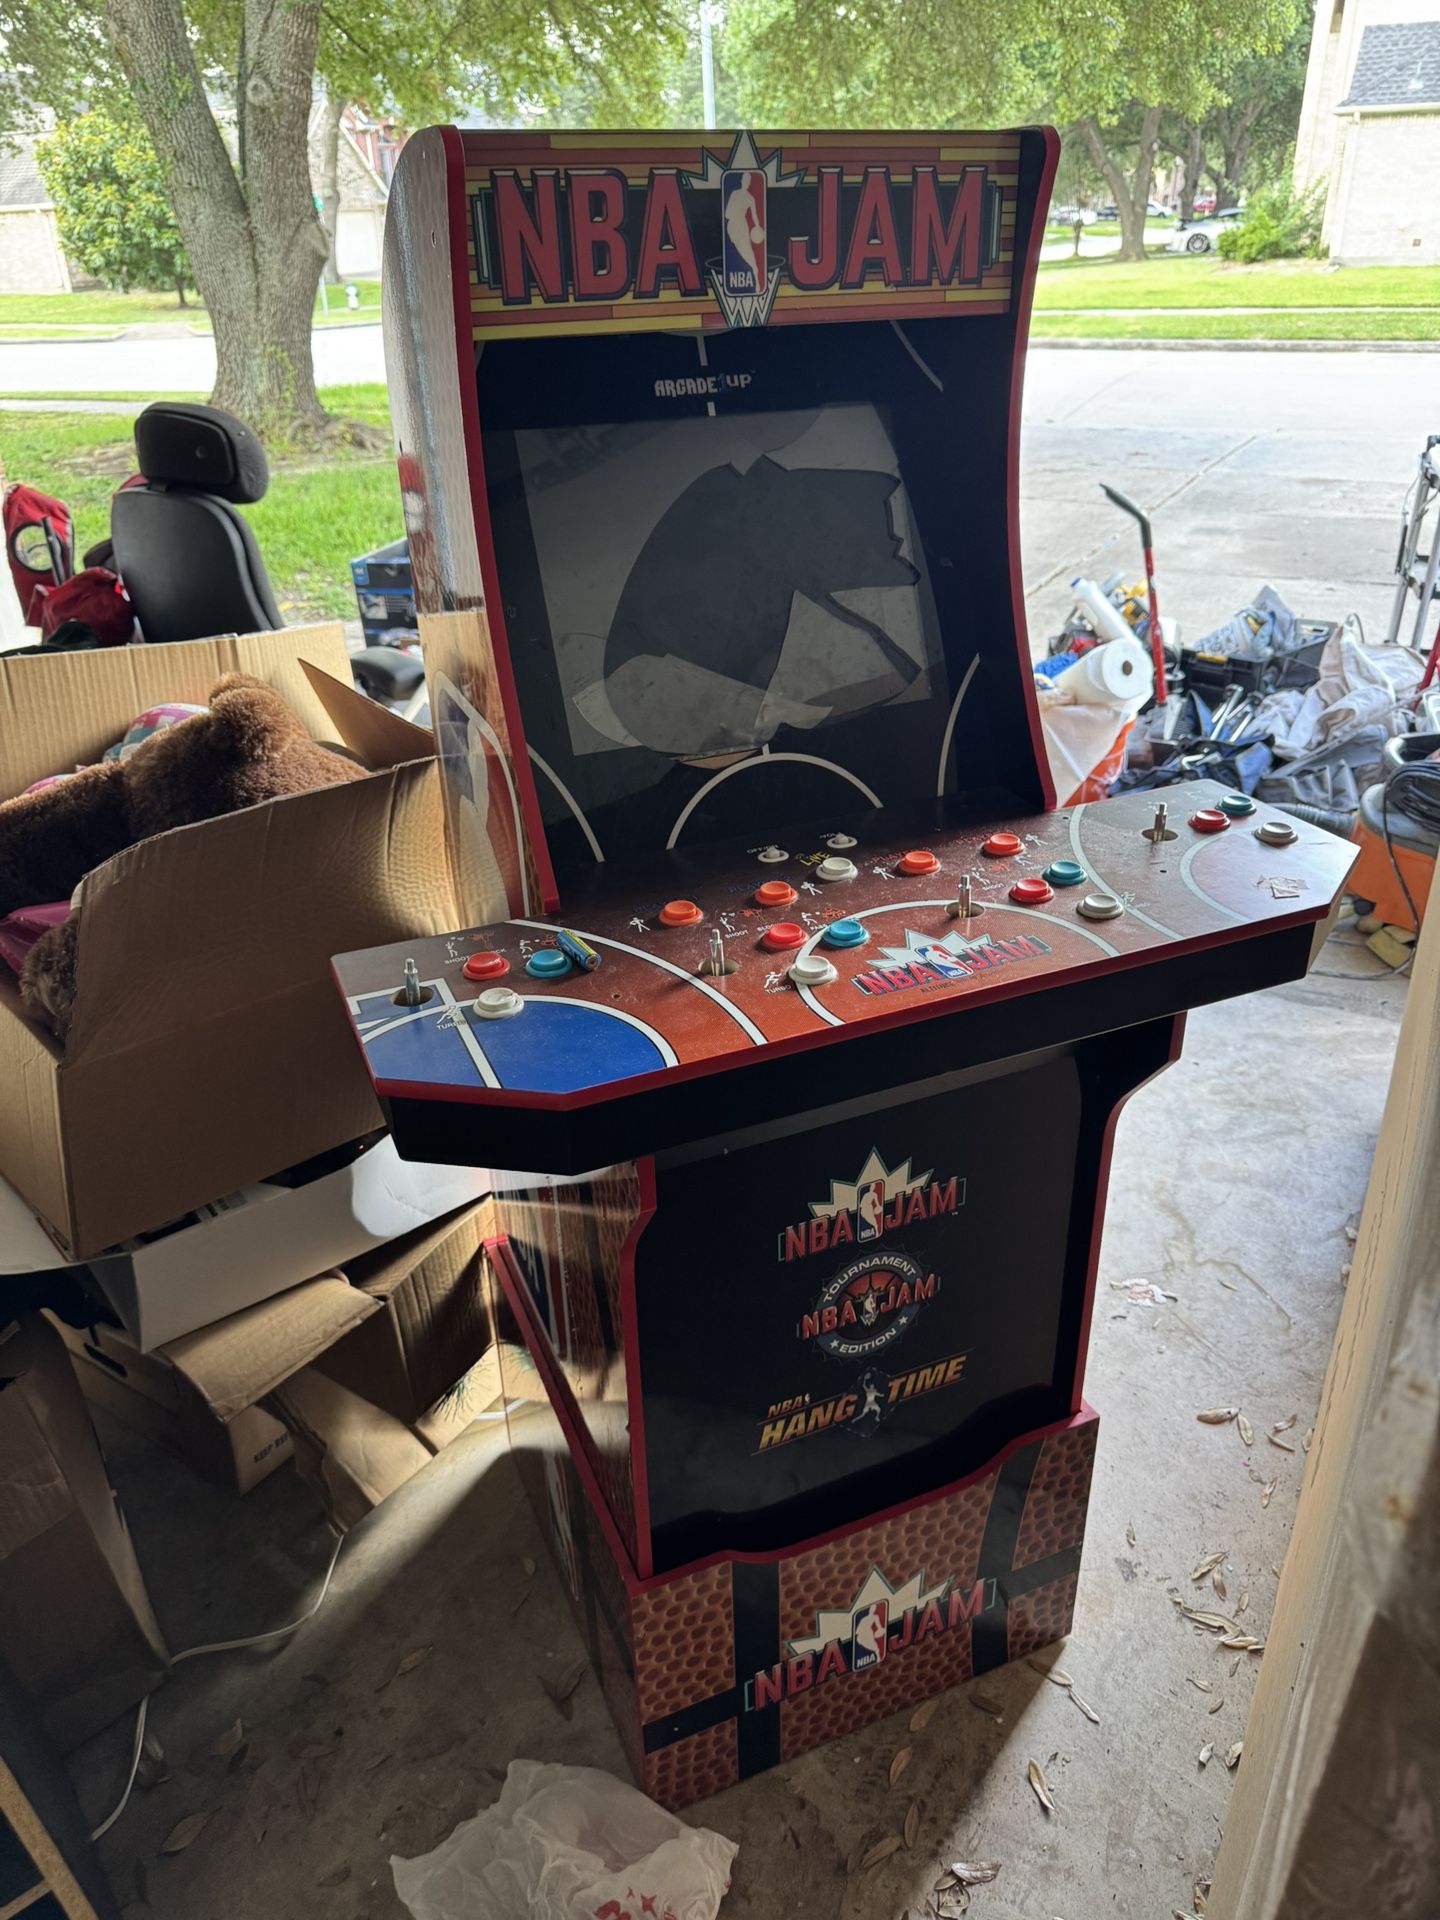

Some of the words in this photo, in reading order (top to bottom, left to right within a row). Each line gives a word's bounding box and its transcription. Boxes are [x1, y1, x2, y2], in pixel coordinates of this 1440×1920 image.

[489, 167, 710, 305] NBA
[787, 165, 988, 291] JAM
[729, 271, 754, 289] NBA
[725, 929, 749, 939] SHOOT
[858, 961, 944, 996] NBA
[965, 935, 1044, 971] JAM
[946, 967, 965, 977] NBA
[765, 983, 792, 995] TURBO
[783, 1209, 854, 1262] NBA
[885, 1176, 958, 1229] JAM
[860, 1229, 876, 1239] NBA
[823, 1255, 917, 1303] TOURNAMENT
[800, 1300, 858, 1340] NBA
[880, 1273, 936, 1314] JAM
[838, 1327, 897, 1354] EDITION
[758, 1393, 859, 1450] HANG
[886, 1354, 967, 1404] TIME
[767, 1394, 804, 1419] NBA
[754, 1637, 849, 1712] NBA
[886, 1577, 987, 1651] JAM
[856, 1652, 876, 1669] NBA
